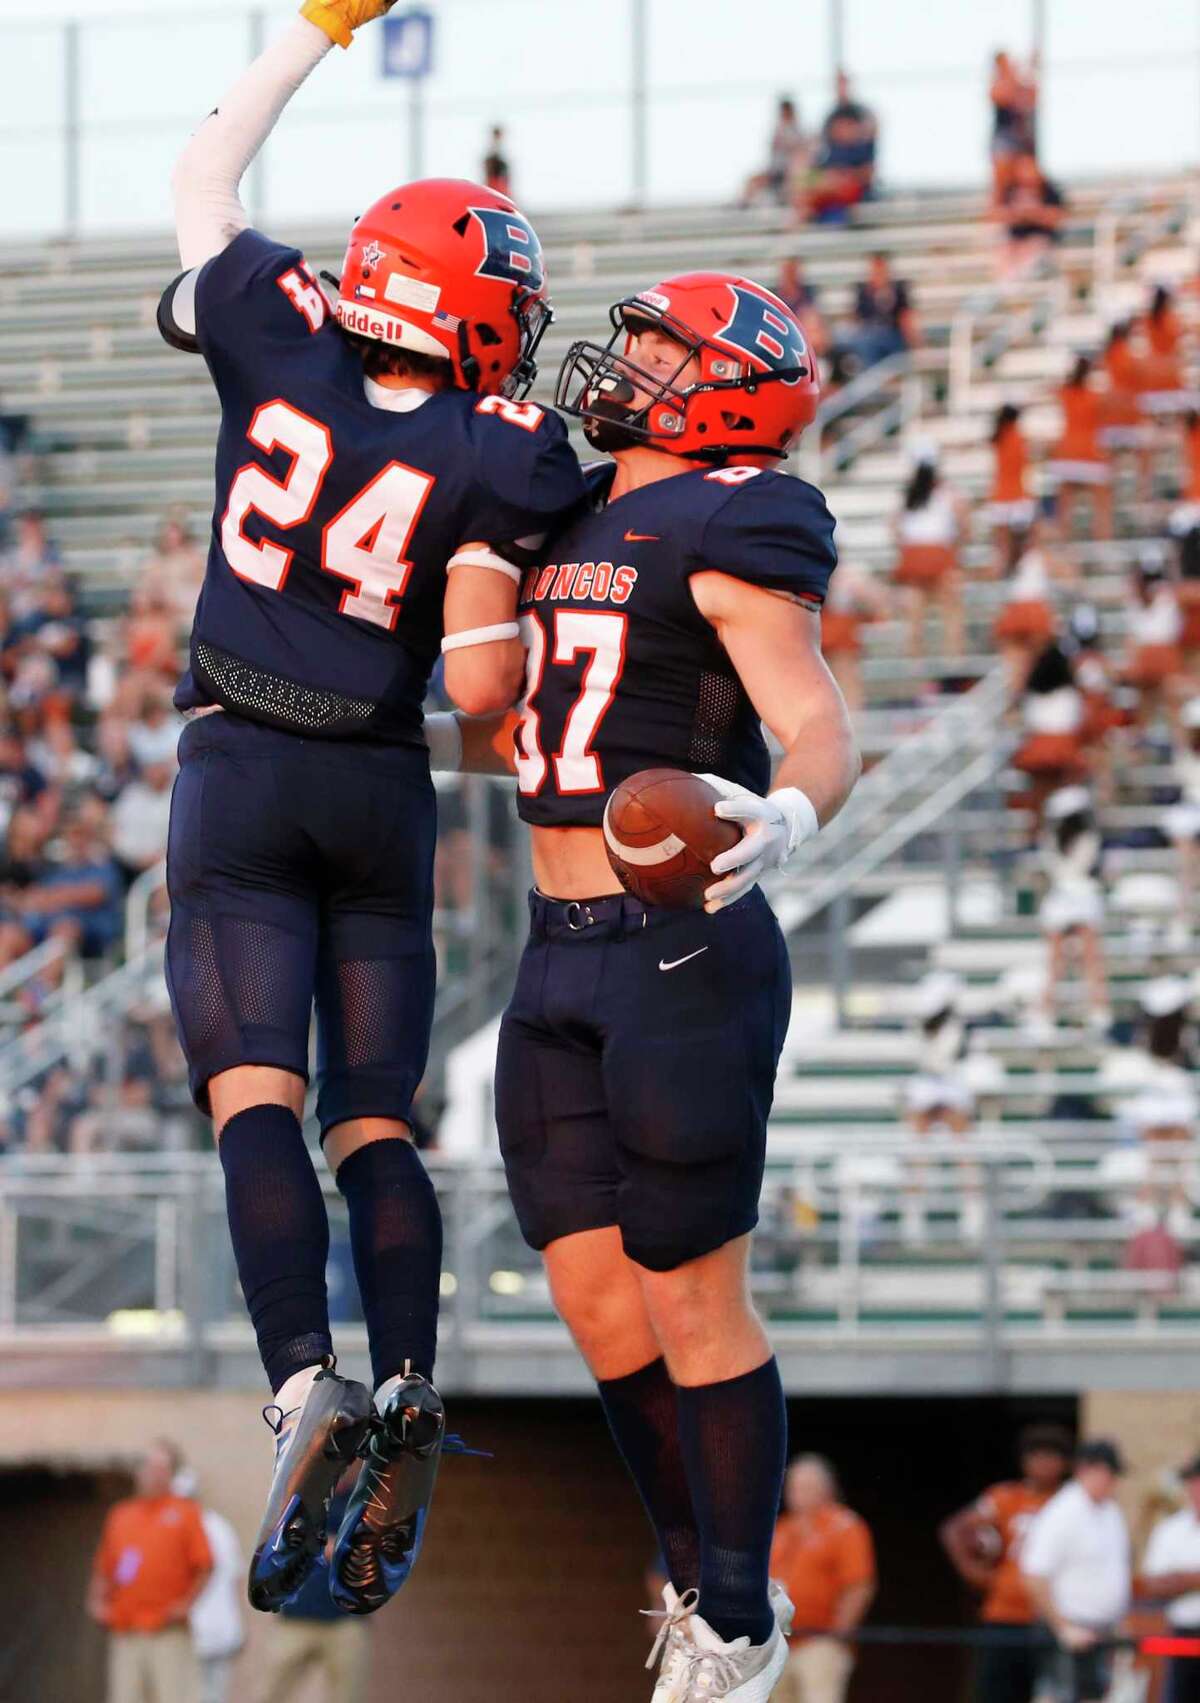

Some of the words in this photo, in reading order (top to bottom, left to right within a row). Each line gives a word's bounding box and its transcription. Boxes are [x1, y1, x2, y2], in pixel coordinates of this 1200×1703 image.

[466, 206, 544, 293] B
[336, 304, 403, 340] Riddell
[712, 283, 807, 386] B
[220, 397, 436, 632] 24
[520, 561, 638, 605] RONCOS
